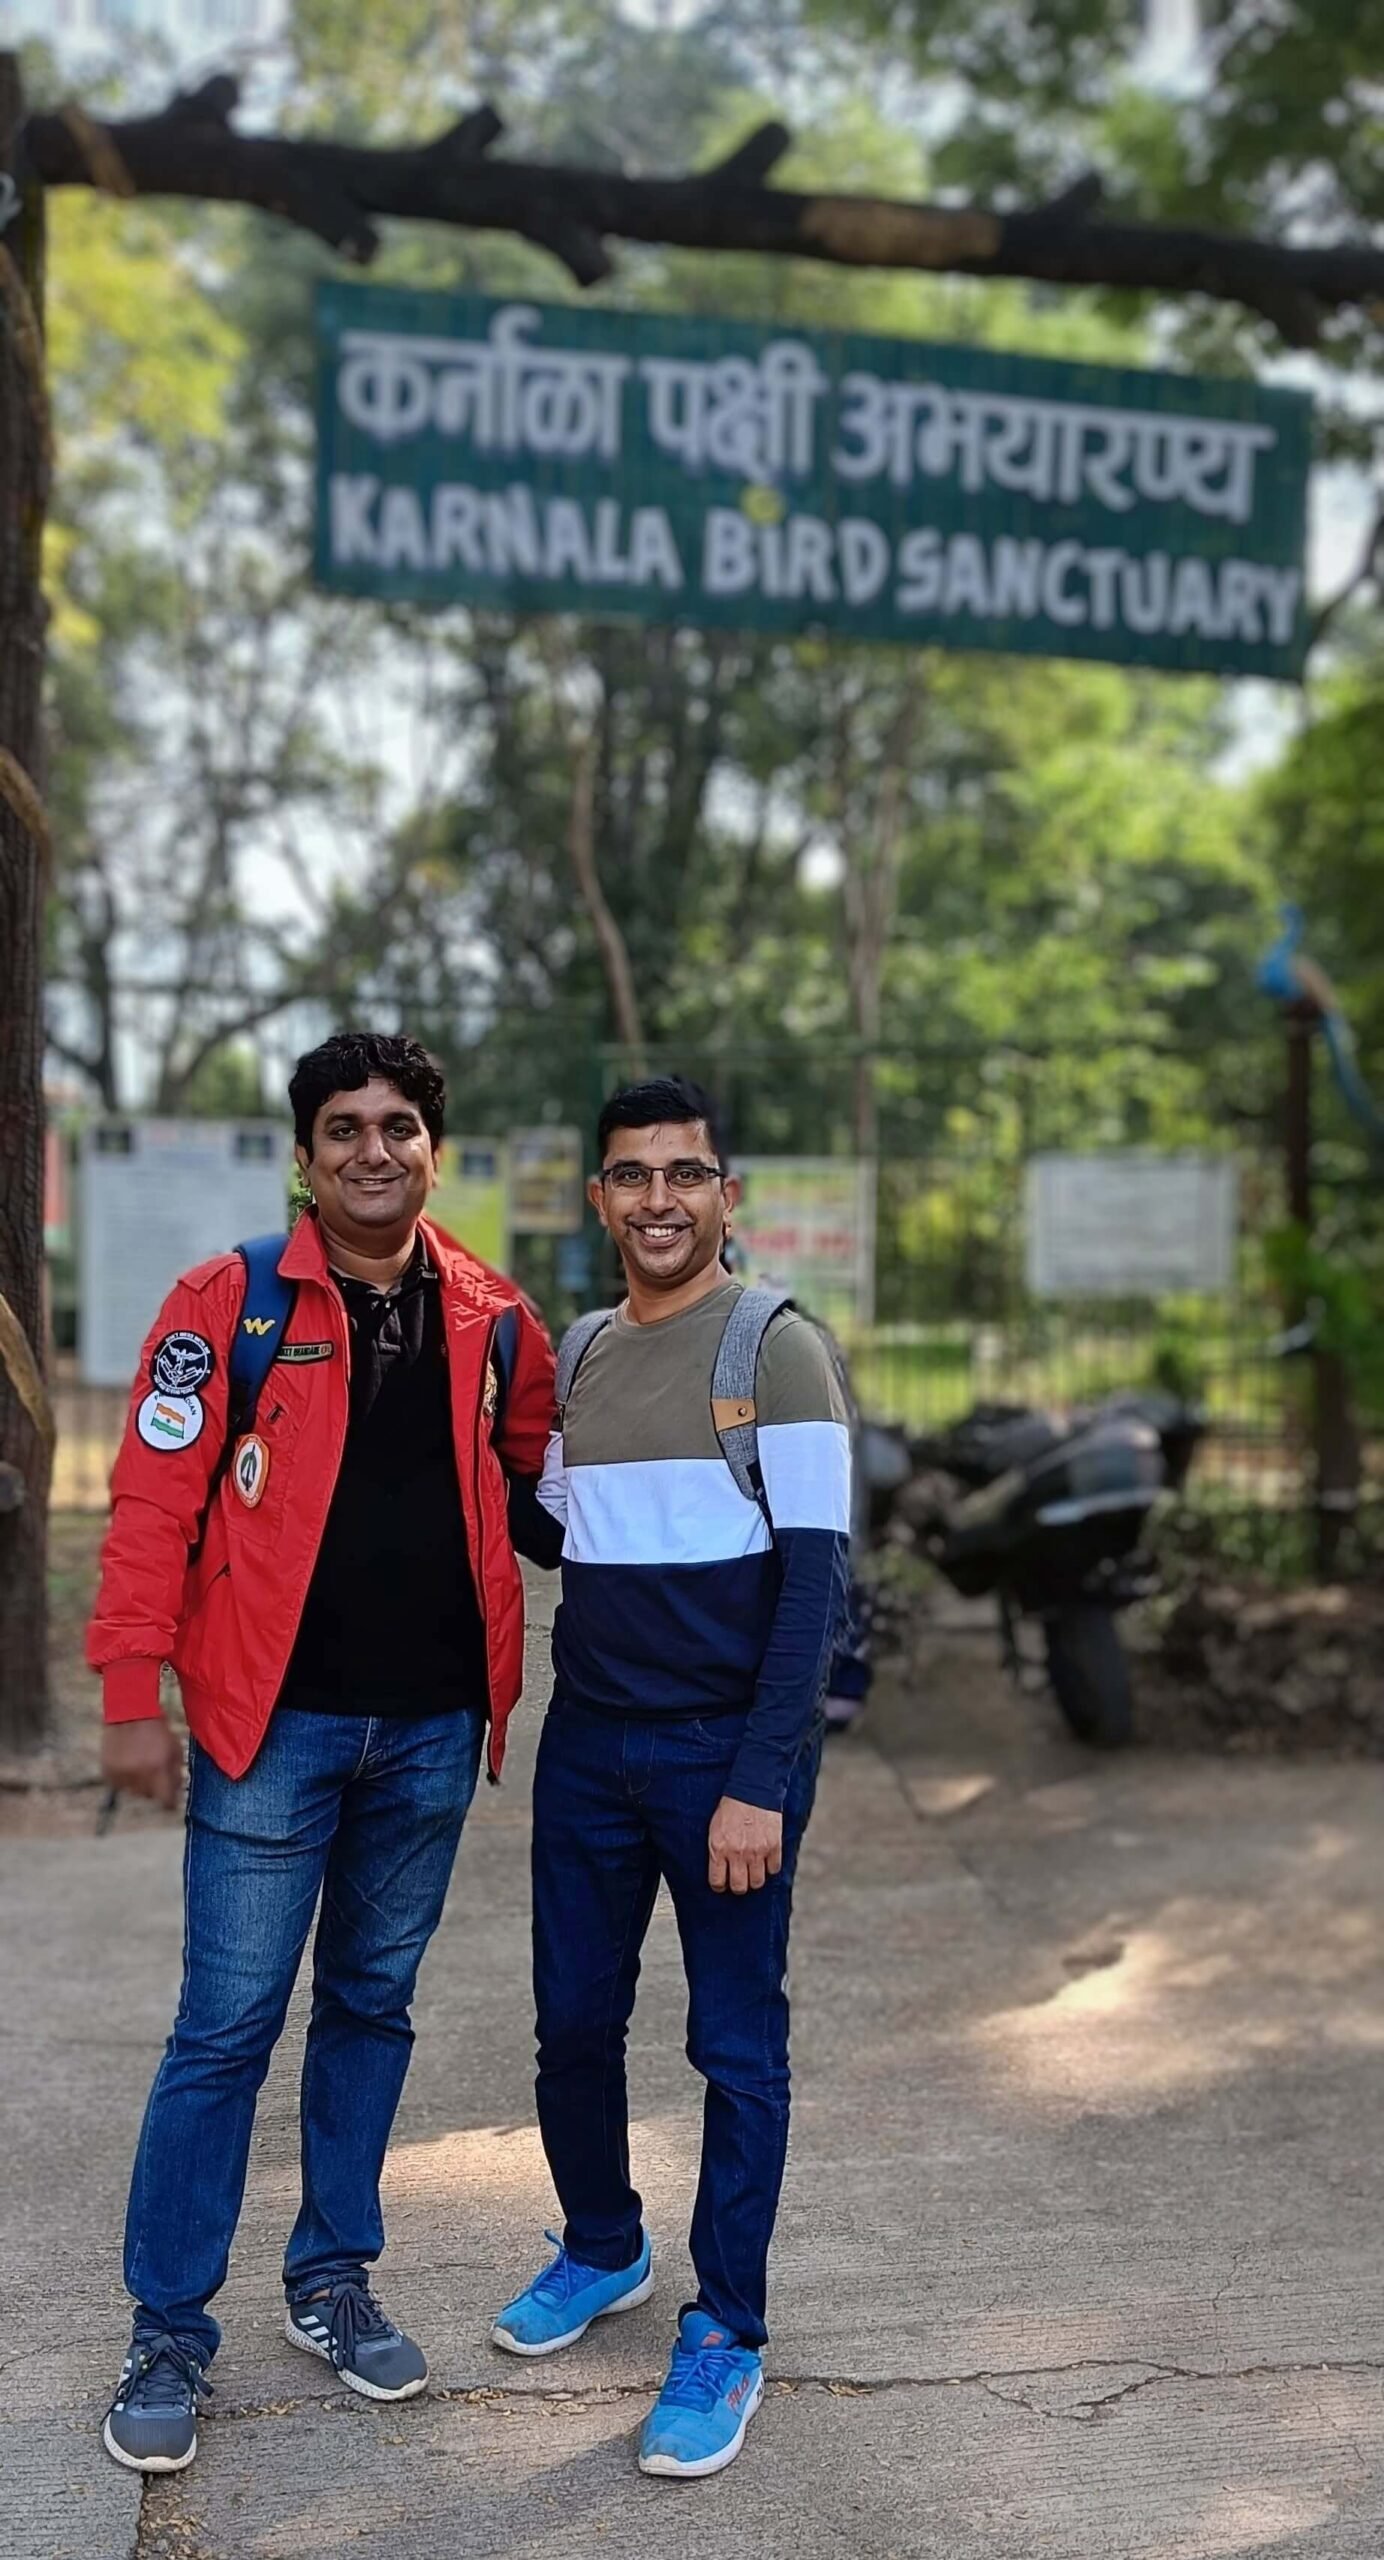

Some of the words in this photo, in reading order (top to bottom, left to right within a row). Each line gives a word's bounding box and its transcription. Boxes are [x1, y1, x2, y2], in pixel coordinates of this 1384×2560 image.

[337, 306, 632, 459] कर्नाळा
[636, 340, 829, 483] पक्षी
[831, 372, 1276, 523] अभयारण्य
[329, 473, 684, 588] KARNALA
[895, 527, 1300, 645] SANCTUARY
